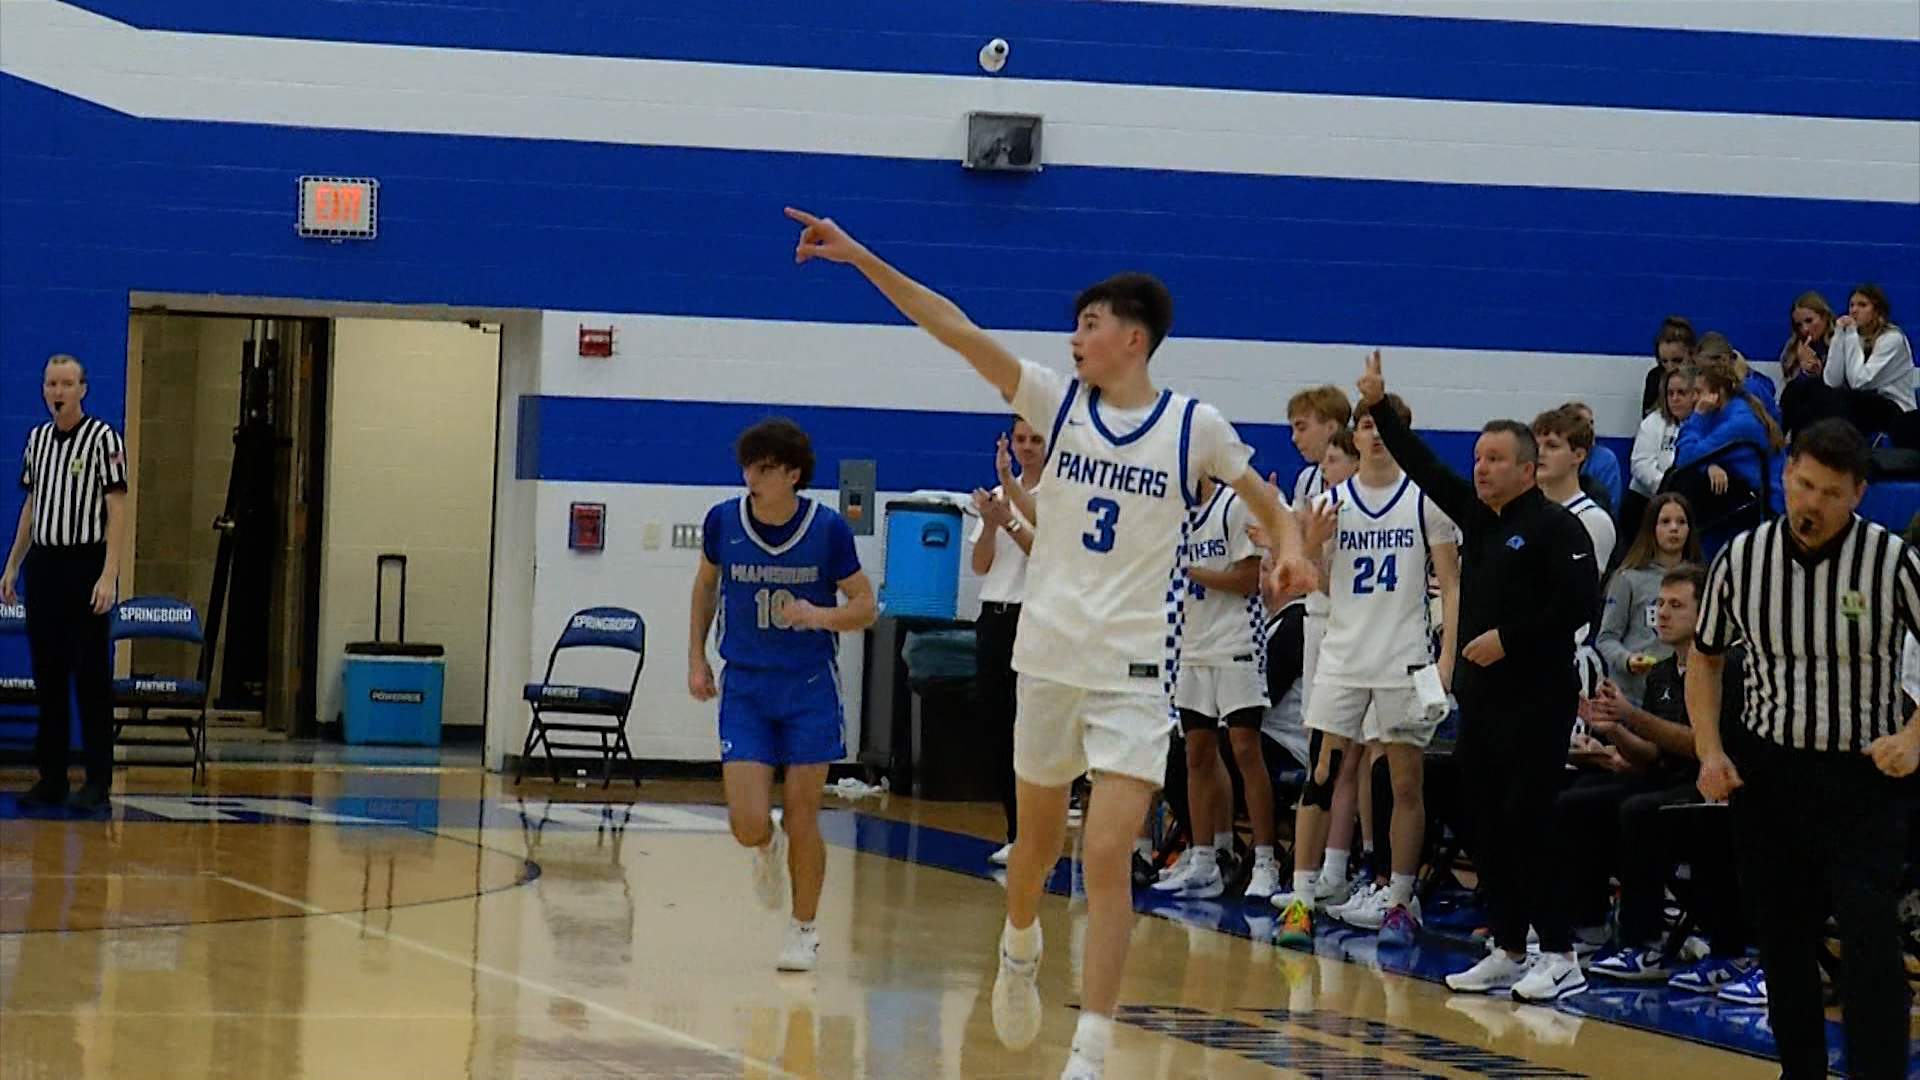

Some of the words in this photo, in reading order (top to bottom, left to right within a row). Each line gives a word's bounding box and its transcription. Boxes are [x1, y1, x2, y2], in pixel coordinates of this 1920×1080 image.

[1057, 451, 1169, 498] PANTHERS
[1082, 497, 1120, 552] 3
[1189, 539, 1226, 561] HERS
[1340, 528, 1414, 550] PANTHERS
[1353, 553, 1398, 594] 24
[119, 606, 192, 623] SPRINGBORO
[135, 681, 177, 692] PANTHERS
